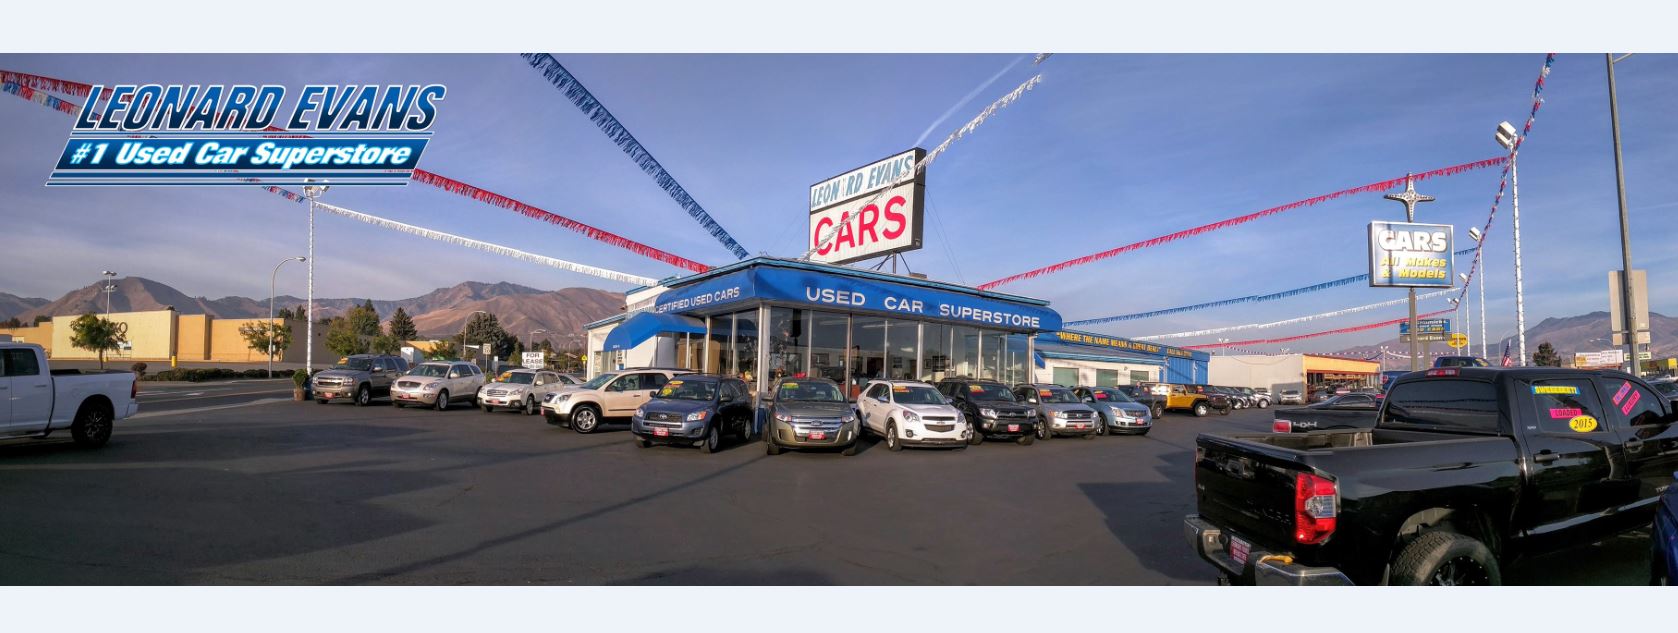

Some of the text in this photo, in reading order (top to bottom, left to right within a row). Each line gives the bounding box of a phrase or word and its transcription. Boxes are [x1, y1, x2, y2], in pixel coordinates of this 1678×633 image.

[811, 155, 914, 208] LEONRD EVANS
[814, 195, 906, 256] CARS
[1378, 230, 1447, 253] CARS
[1380, 256, 1447, 268] All Makes
[1381, 268, 1447, 279] & Models
[654, 286, 740, 314] CERTIFIED USED CARS
[806, 286, 1041, 328] USED CAR SUPERSTORE
[1083, 335, 1093, 344] THE
[1555, 408, 1578, 417] LOADED
[1573, 418, 1593, 430] 2015
